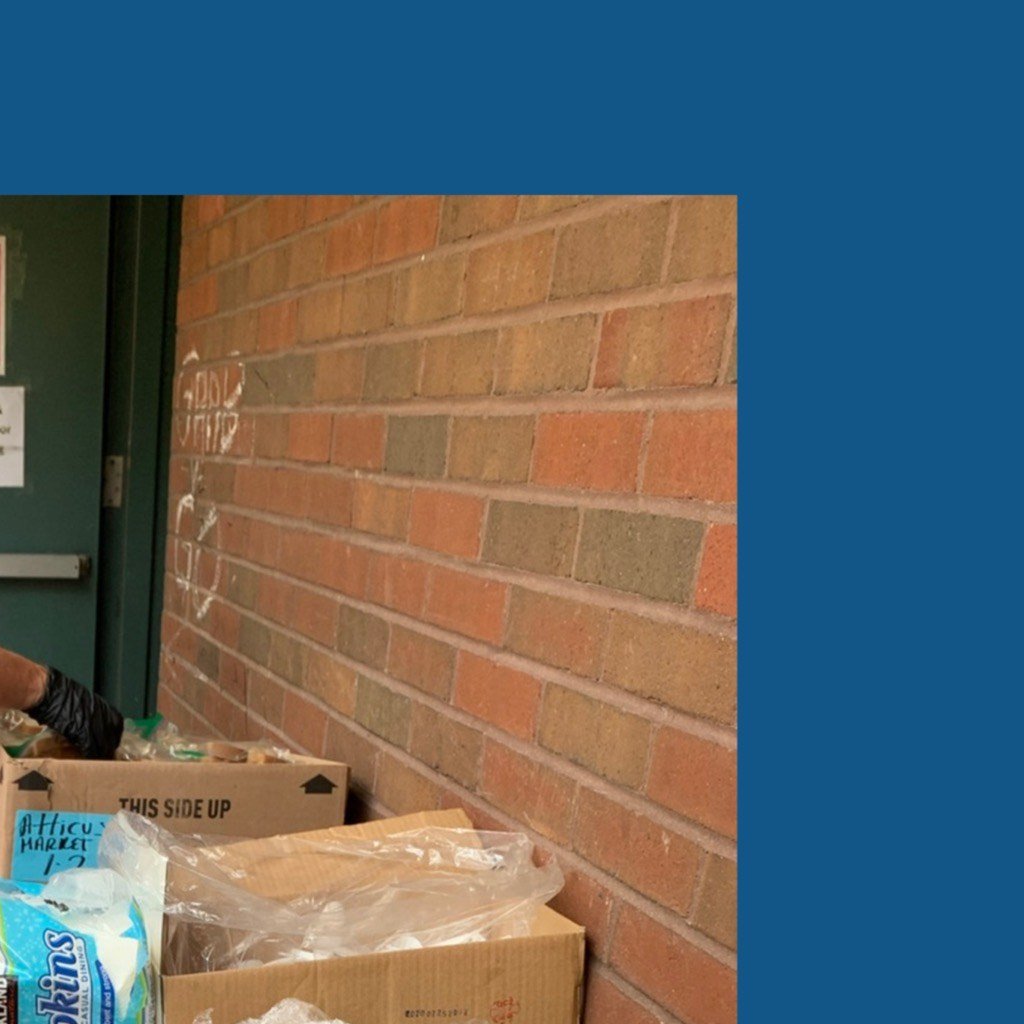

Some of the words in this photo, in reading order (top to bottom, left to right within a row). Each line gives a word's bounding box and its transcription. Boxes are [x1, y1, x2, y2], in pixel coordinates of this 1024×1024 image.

[119, 798, 159, 818] THIS
[164, 799, 203, 819] SIDE
[208, 799, 232, 819] UP
[21, 837, 93, 853] MARKET
[76, 945, 89, 982] DINING
